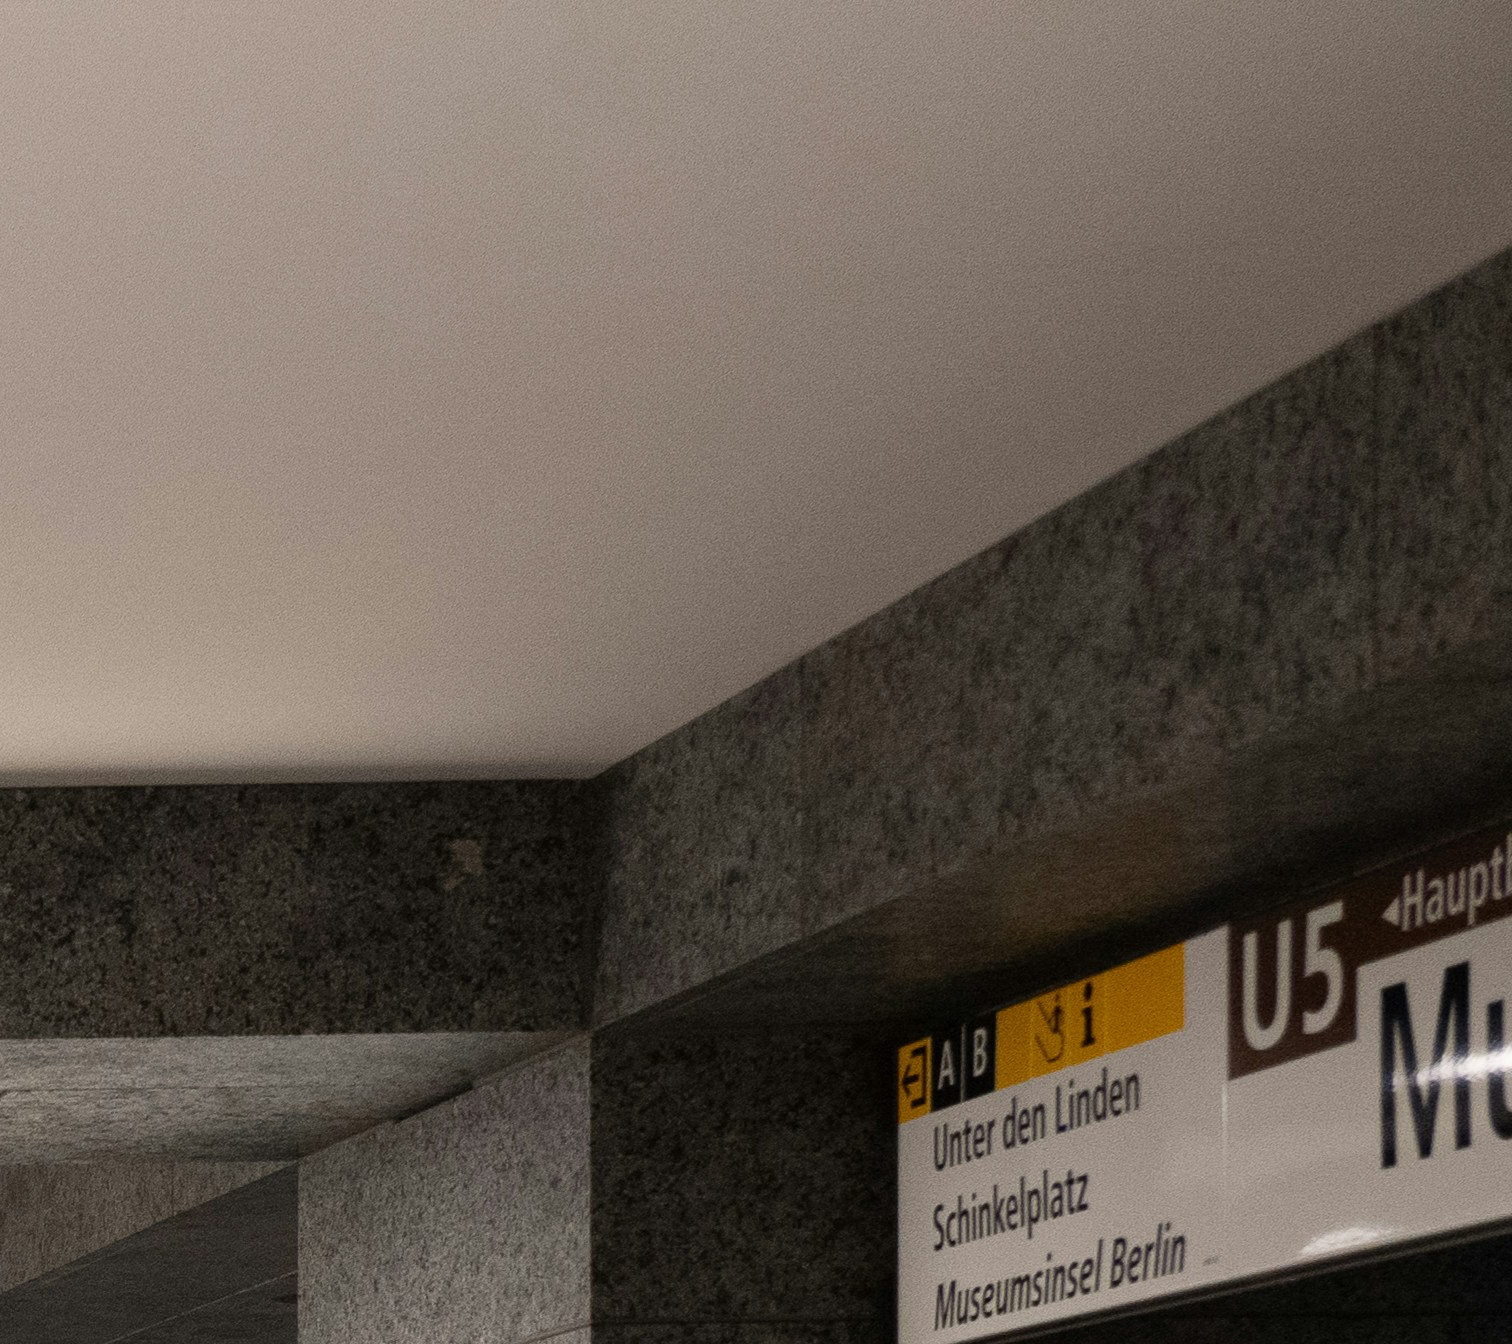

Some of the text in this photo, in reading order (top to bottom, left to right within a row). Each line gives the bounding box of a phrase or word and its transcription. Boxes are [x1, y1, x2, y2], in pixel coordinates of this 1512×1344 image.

[1241, 901, 1345, 1052] U5
[937, 1026, 988, 1092] A B
[933, 1069, 1141, 1172] Unter den Linden
[932, 1171, 1090, 1253] Schinkelplatz
[934, 1221, 1188, 1331] Museumsinsel Berlin
